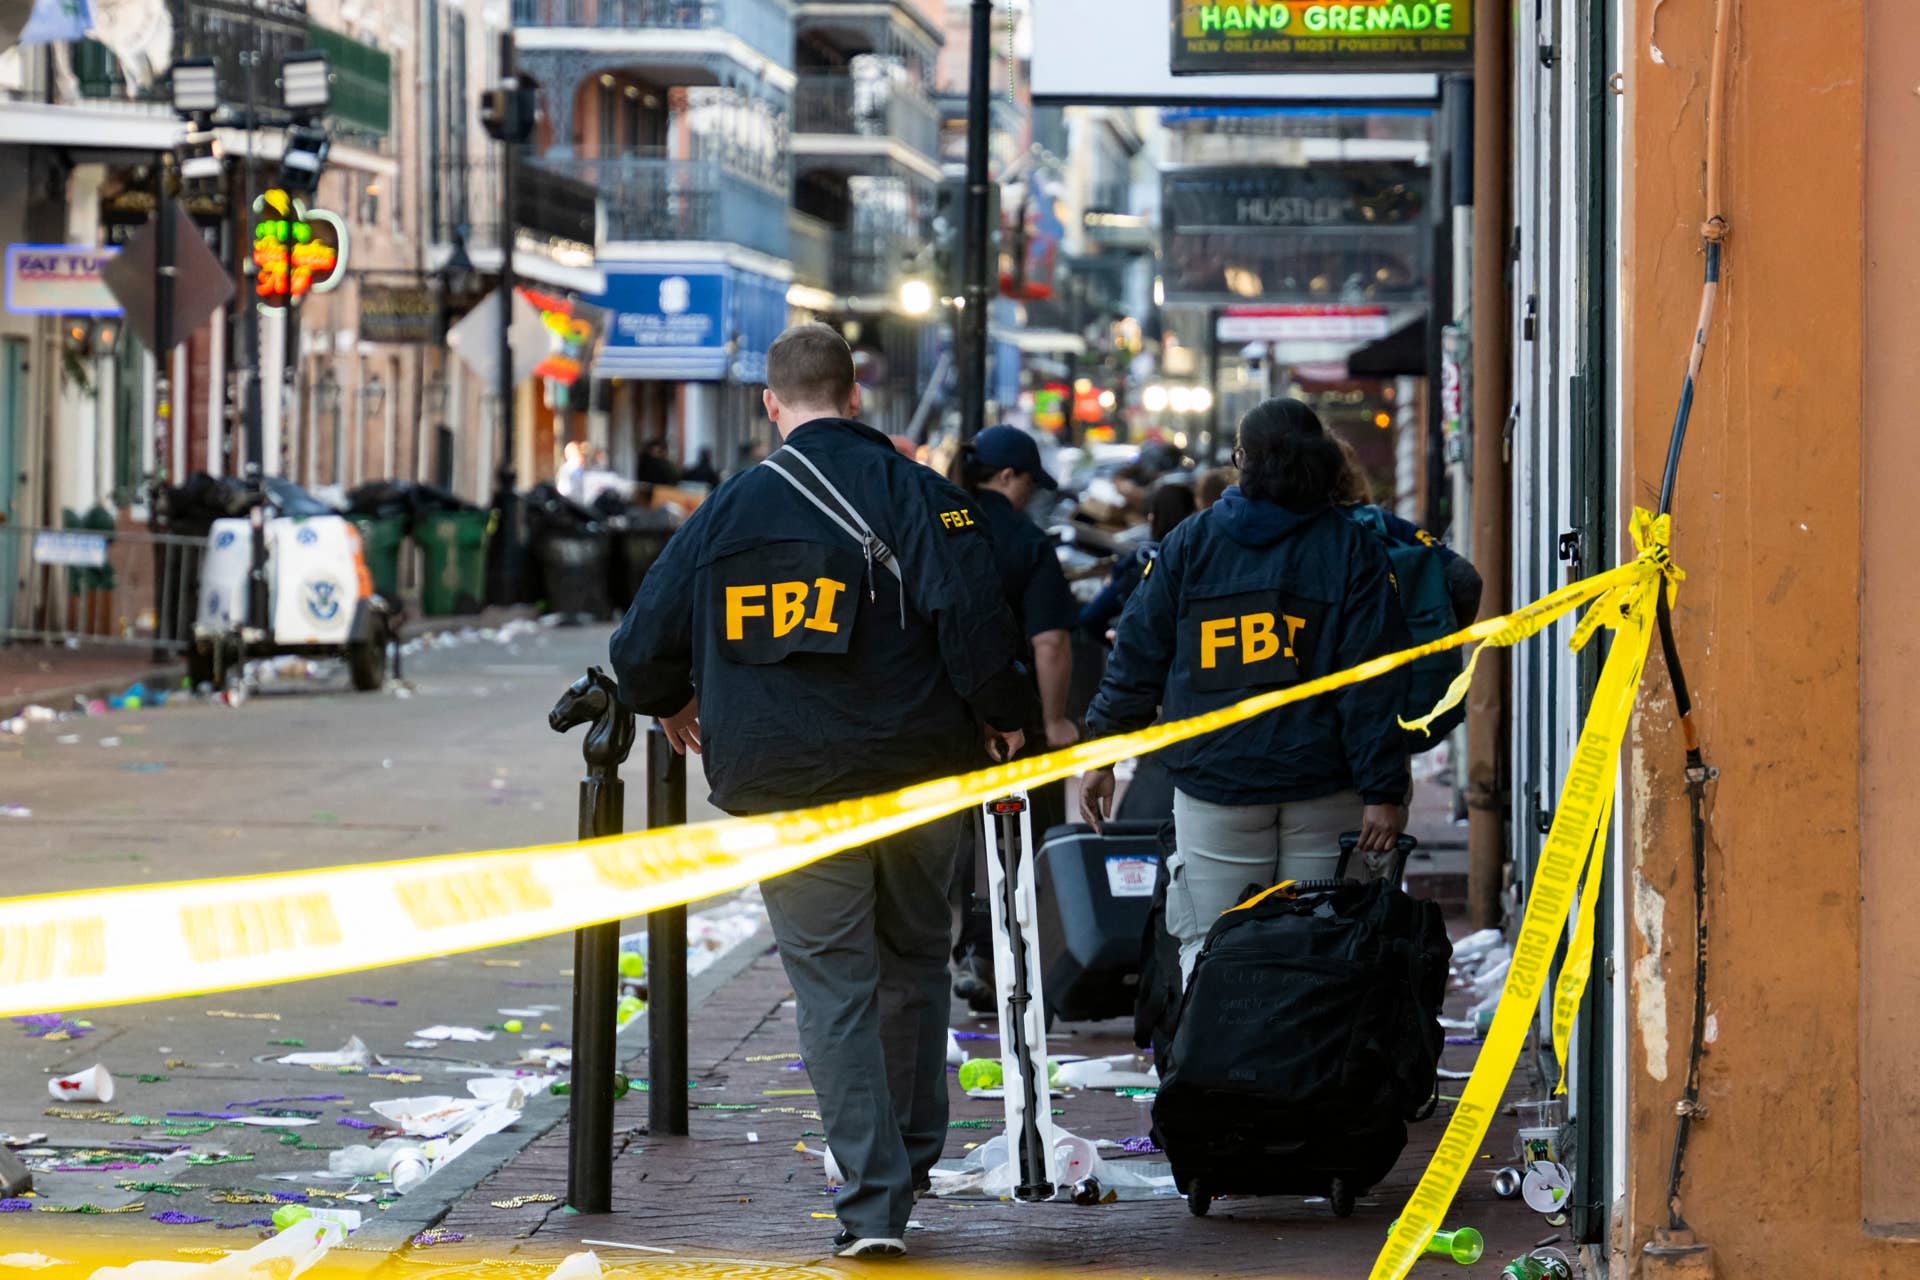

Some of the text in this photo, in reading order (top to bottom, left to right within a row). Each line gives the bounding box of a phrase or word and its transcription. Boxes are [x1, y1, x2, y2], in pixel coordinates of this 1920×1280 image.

[1200, 3, 1452, 32] HAND GRENADE
[1187, 38, 1466, 52] NEW ORLEANS MOST POWERFUL DRINK
[939, 508, 974, 529] FBI
[725, 577, 846, 640] FBI
[1200, 611, 1306, 669] FBI
